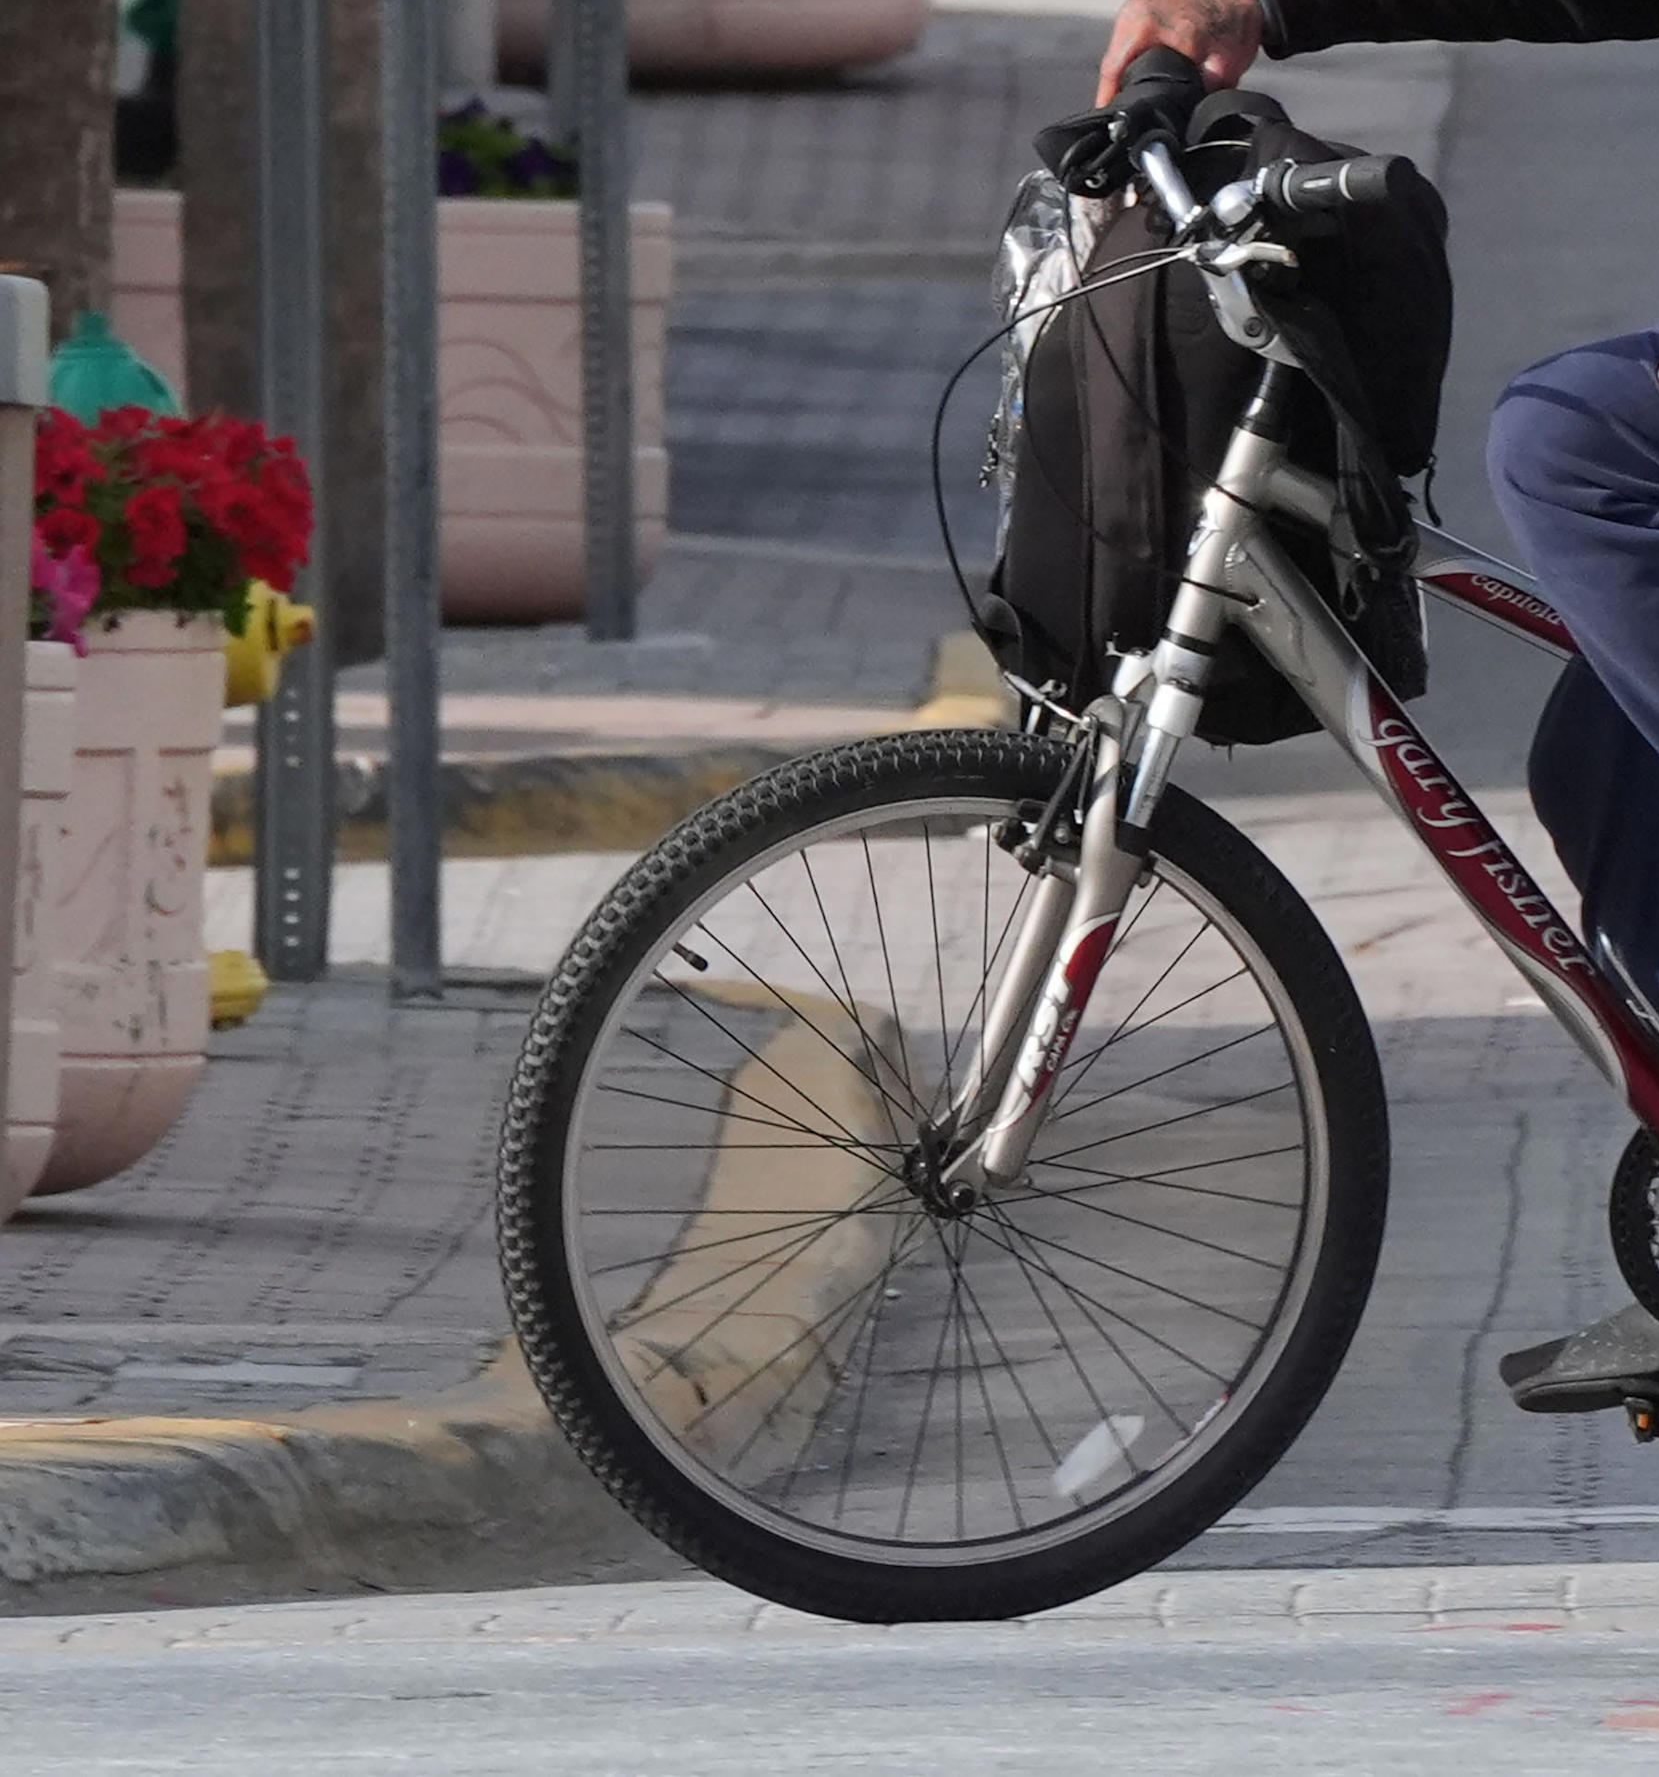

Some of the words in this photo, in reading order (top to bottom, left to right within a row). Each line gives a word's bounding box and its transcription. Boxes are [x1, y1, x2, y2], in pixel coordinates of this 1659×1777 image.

[1357, 718, 1481, 826] gary
[1448, 838, 1595, 977] fisher
[1018, 960, 1071, 1089] RST
